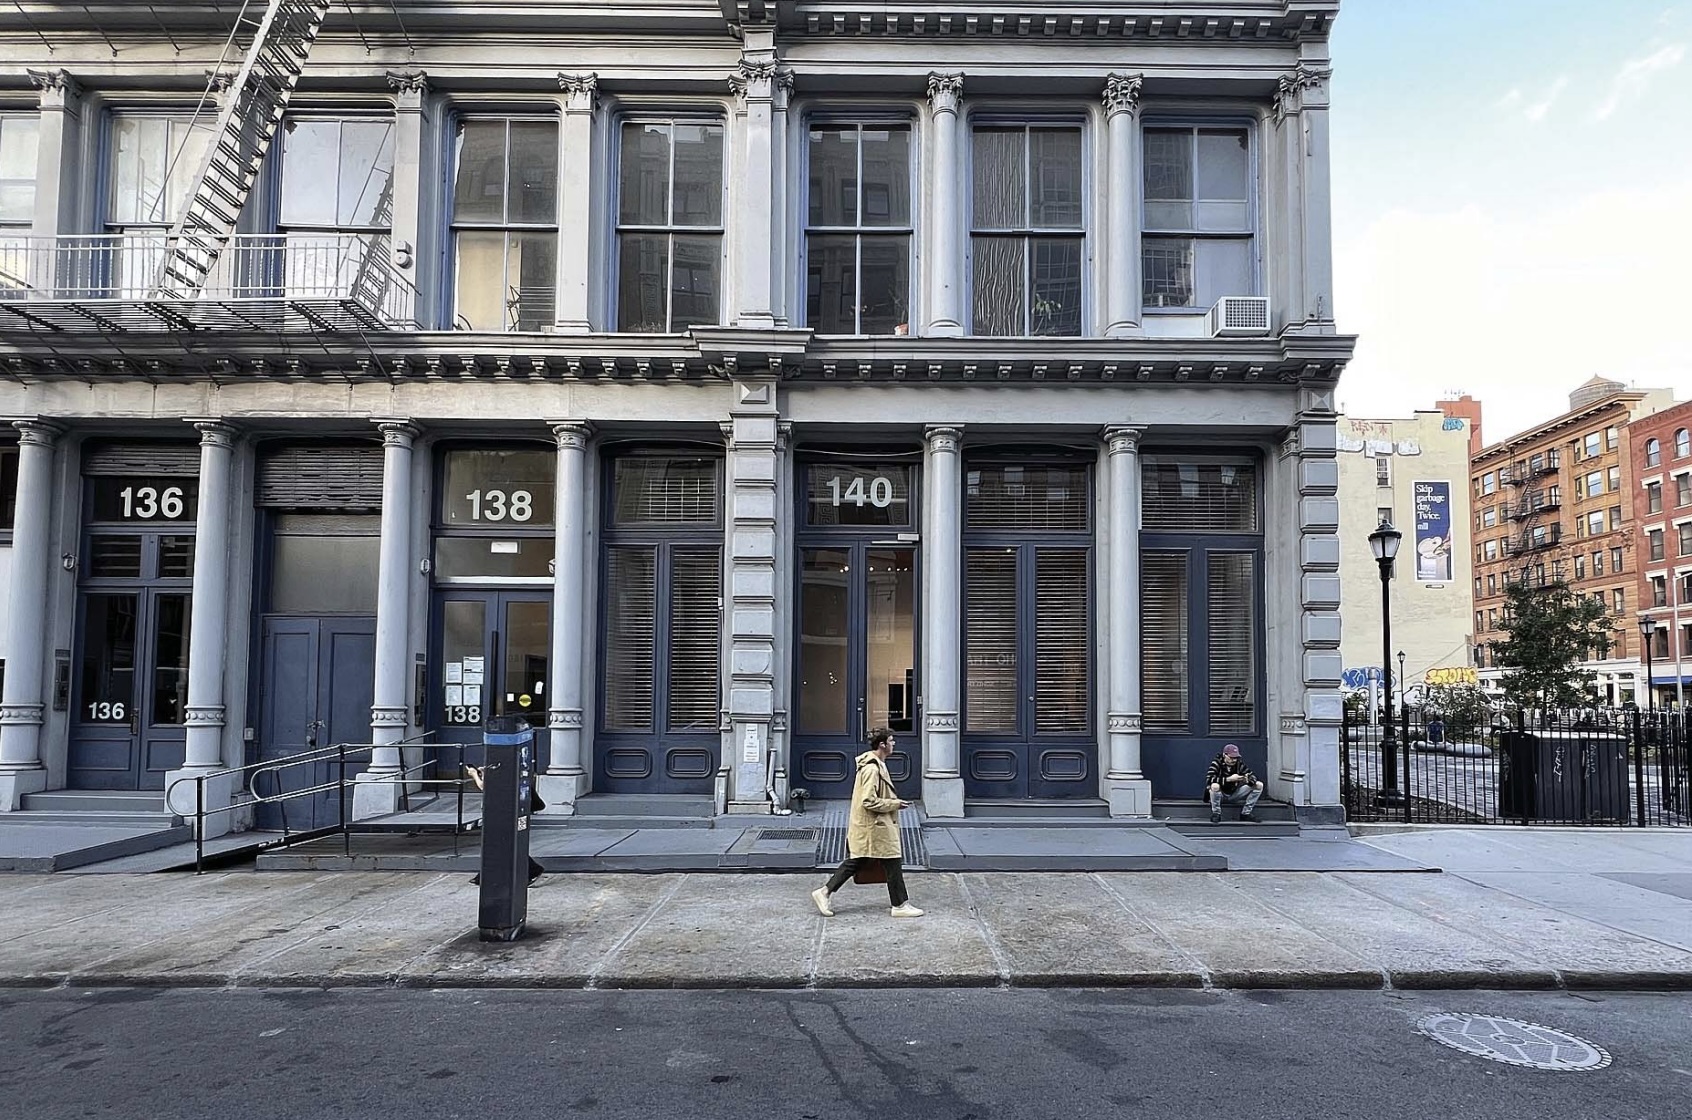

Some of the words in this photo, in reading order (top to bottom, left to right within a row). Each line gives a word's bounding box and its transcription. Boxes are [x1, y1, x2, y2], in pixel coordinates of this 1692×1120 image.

[826, 476, 892, 508] 140
[1416, 484, 1434, 497] Skip
[1416, 495, 1446, 504] garbage
[120, 486, 184, 518] 136
[466, 489, 533, 522] 138
[88, 702, 125, 720] 136
[444, 706, 481, 723] 138
